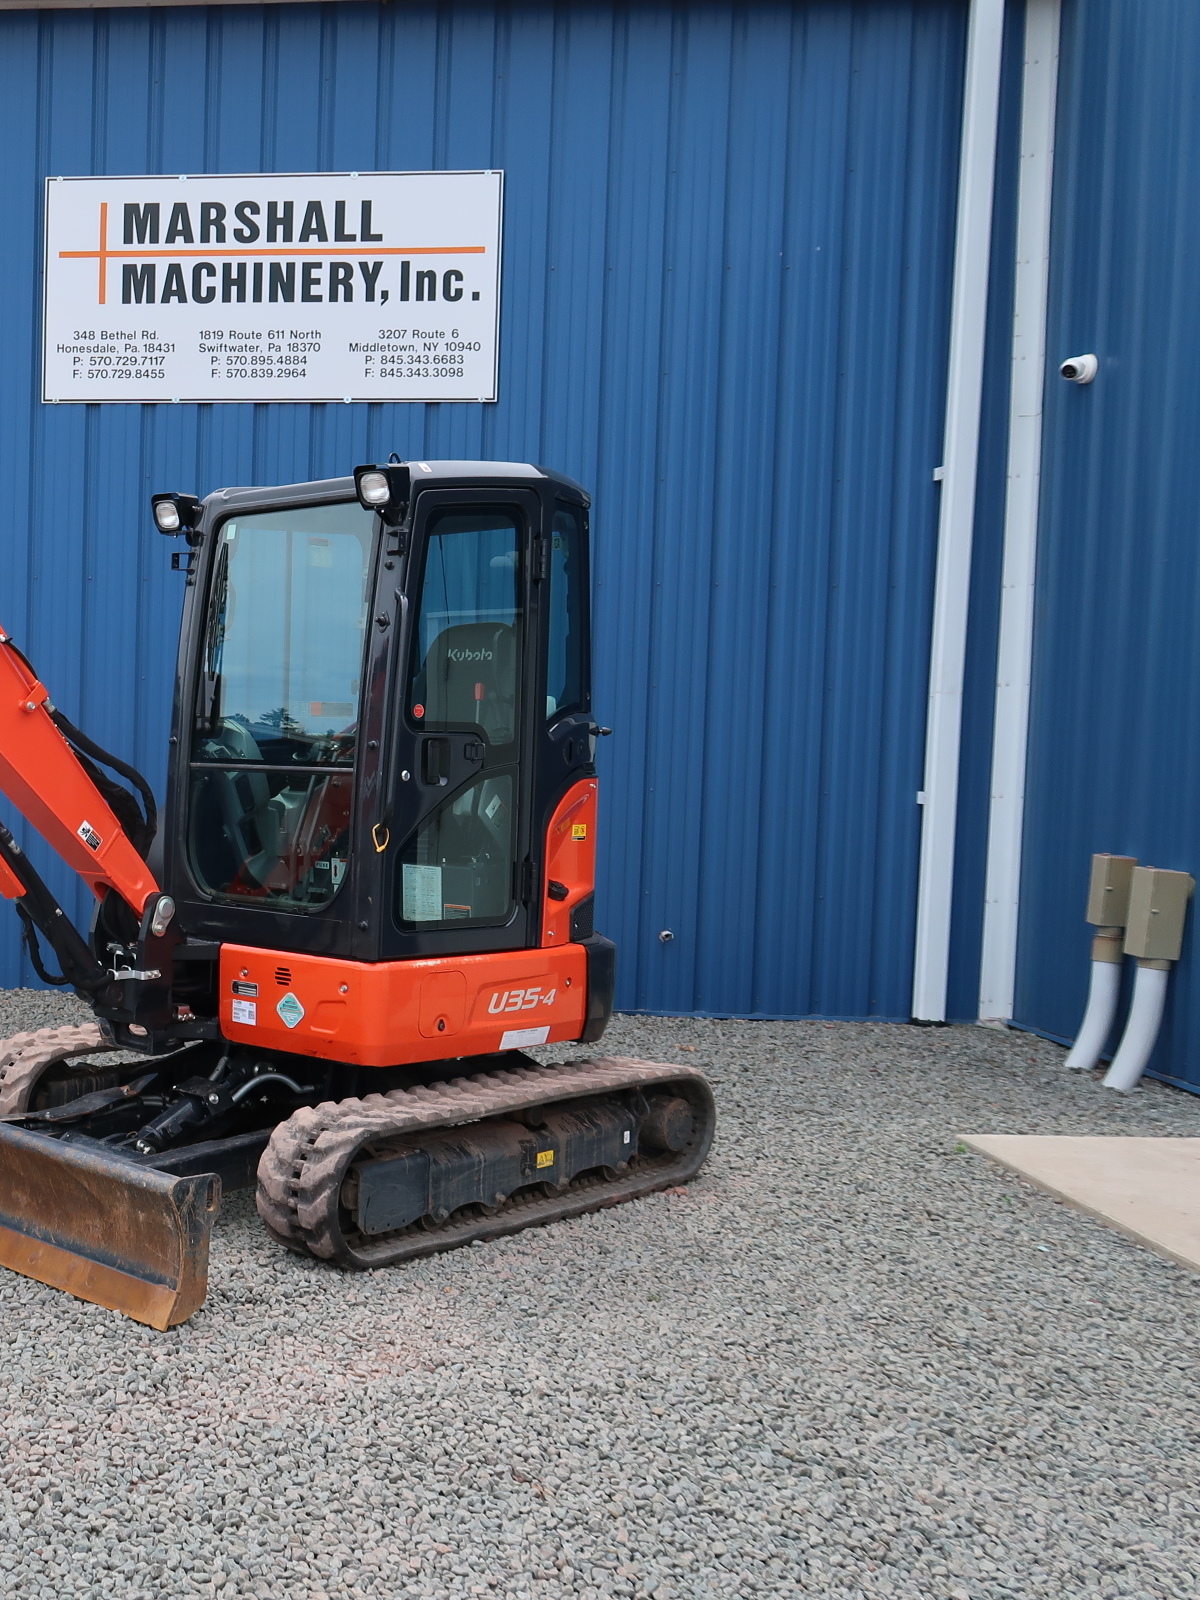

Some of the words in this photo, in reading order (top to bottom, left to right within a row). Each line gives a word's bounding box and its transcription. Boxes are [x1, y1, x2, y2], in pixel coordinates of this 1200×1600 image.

[123, 199, 384, 245] MARSHALL
[122, 261, 390, 306] MACHINERY,
[399, 260, 481, 303] Inc.
[73, 330, 96, 341] 348
[100, 330, 137, 341] Bethel
[141, 330, 160, 341] Rd.
[198, 330, 224, 341] 1819
[228, 330, 263, 341] Route
[267, 330, 285, 341] 611
[289, 329, 322, 340] North
[377, 329, 407, 340] 3207
[411, 329, 446, 340] Route
[451, 329, 460, 339] 6
[56, 343, 119, 354] Honesdale,
[124, 343, 140, 353] Pa.
[142, 342, 176, 353] 18431
[198, 343, 263, 355] Swiftwater,
[267, 343, 282, 353] Pa
[286, 342, 321, 353] 18370
[348, 342, 418, 354] Middletown,
[423, 342, 440, 353] NY
[444, 341, 482, 352] 10940
[72, 356, 84, 366] P:
[89, 356, 166, 366] 570.729.7117
[210, 356, 221, 366] P:
[225, 355, 308, 366] 570.895.4884
[364, 355, 375, 365] P:
[380, 354, 465, 365] 845.343.6683
[72, 369, 83, 379] F:
[87, 369, 166, 379] 570.729.8455
[211, 368, 222, 379] F:
[225, 368, 307, 379] 570.839.2964
[364, 368, 375, 378] F:
[379, 367, 465, 378] 845.343.3098
[447, 648, 493, 662] Kubota
[487, 987, 557, 1014] U35-4
